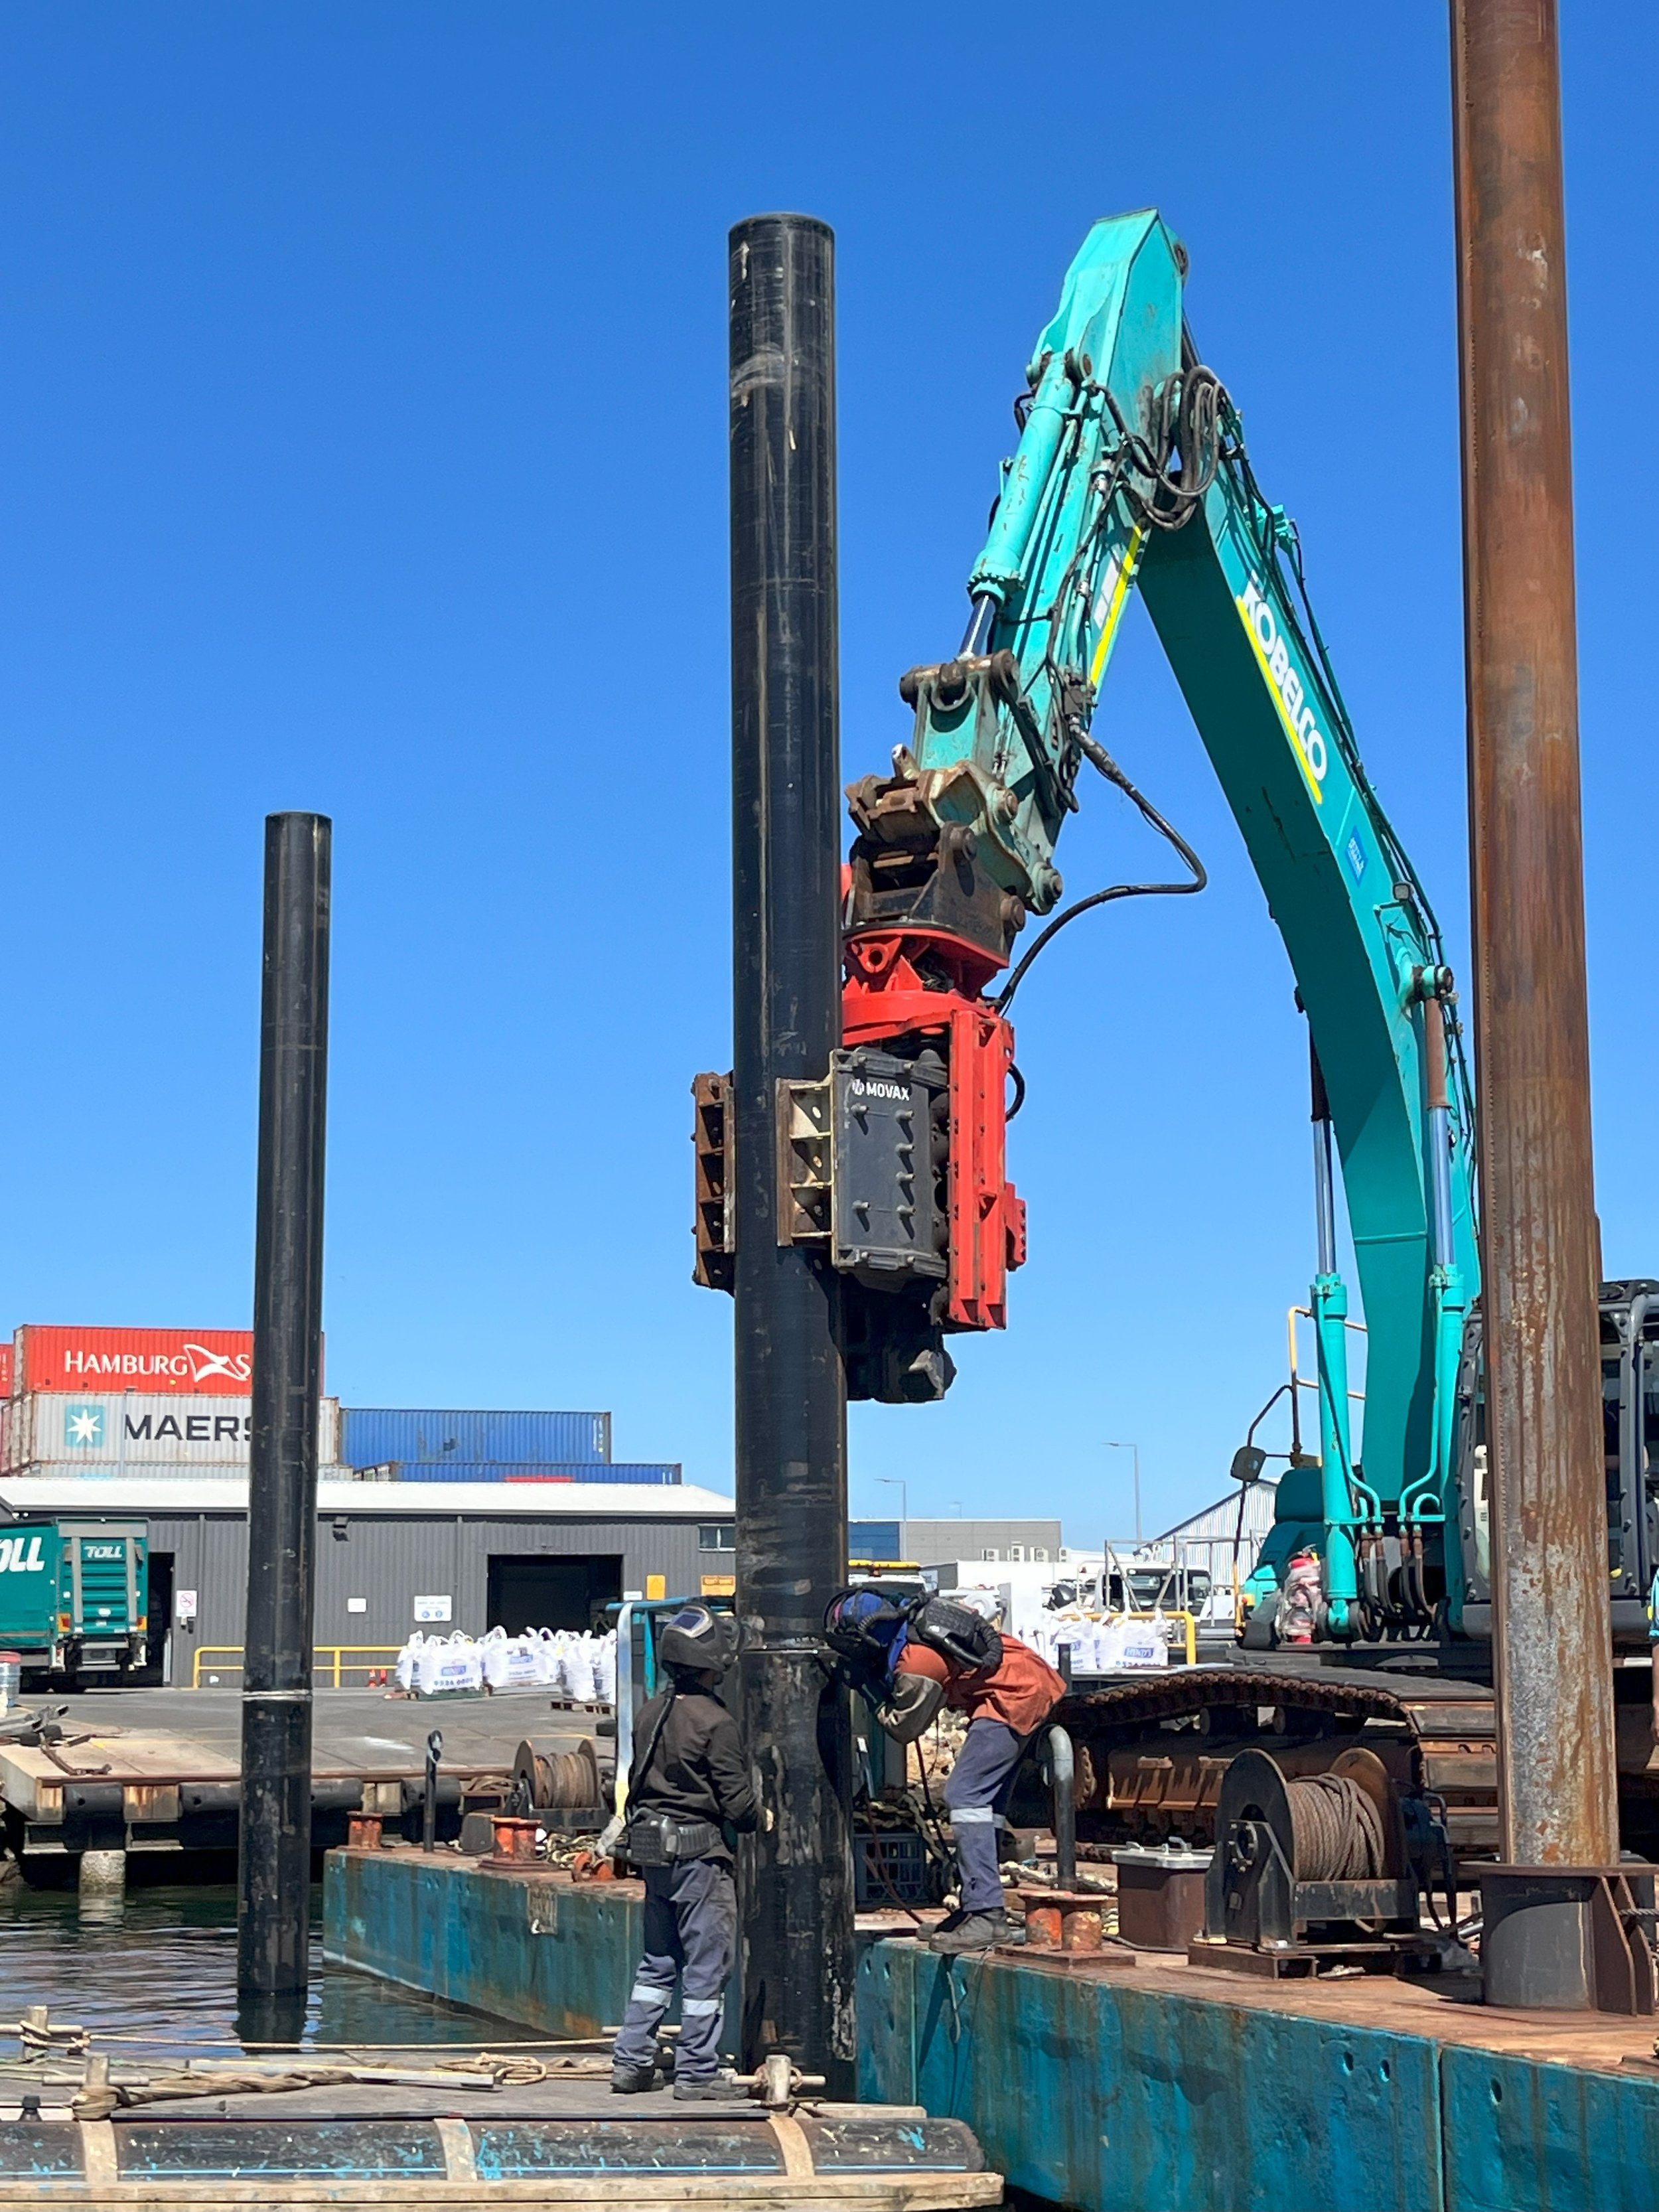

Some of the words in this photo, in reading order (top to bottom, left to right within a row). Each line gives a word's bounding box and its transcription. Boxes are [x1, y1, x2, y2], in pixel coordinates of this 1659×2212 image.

[1242, 569, 1327, 781] KOBELCO
[865, 1081, 910, 1101] MOVAX
[64, 1349, 188, 1376] HAMBURG
[0, 1536, 45, 1573] OLL
[84, 1545, 123, 1558] TOLL
